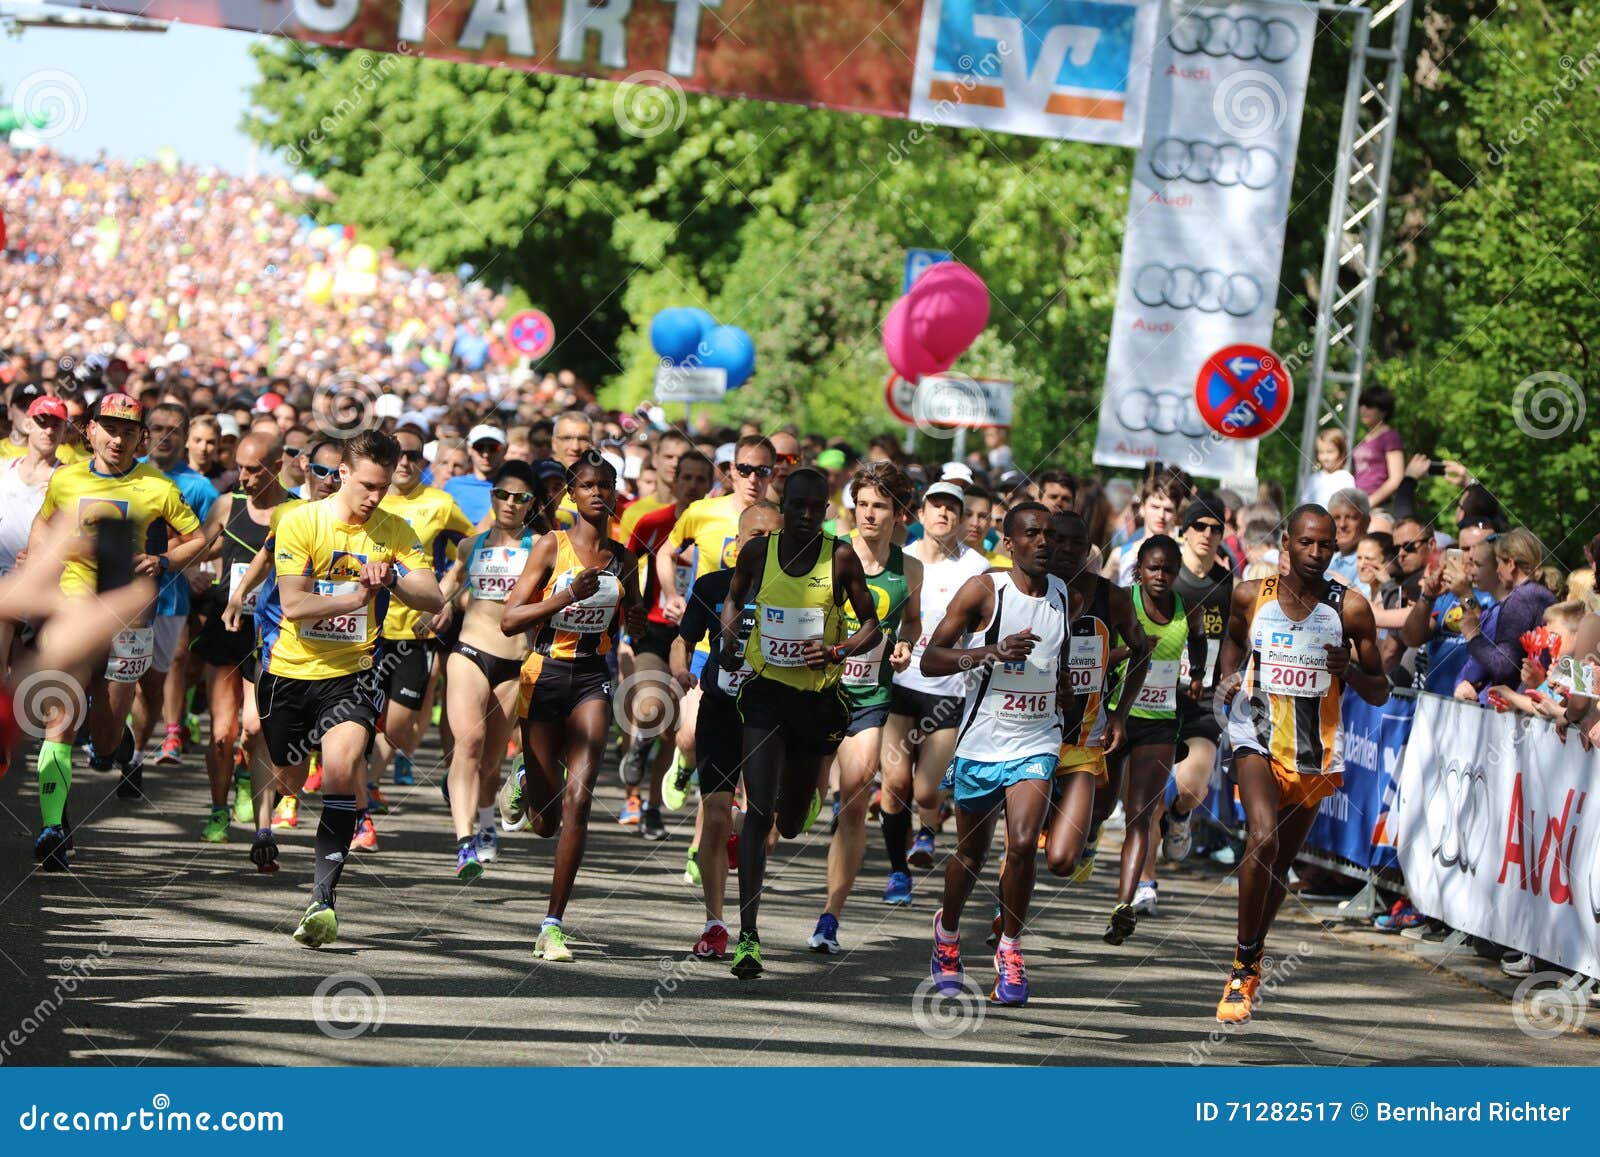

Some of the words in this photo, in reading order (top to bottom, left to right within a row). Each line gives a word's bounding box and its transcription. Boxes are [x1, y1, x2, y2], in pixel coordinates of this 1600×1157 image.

[1166, 64, 1210, 80] Audi
[1149, 192, 1192, 208] Audi
[1132, 317, 1175, 334] Audi
[1115, 440, 1160, 457] Audi
[312, 614, 357, 633] 2326
[563, 607, 605, 624] F222
[118, 659, 147, 675] 2331
[1270, 667, 1318, 689] 2001
[1003, 693, 1047, 712] 2416
[1497, 771, 1588, 906] Audi
